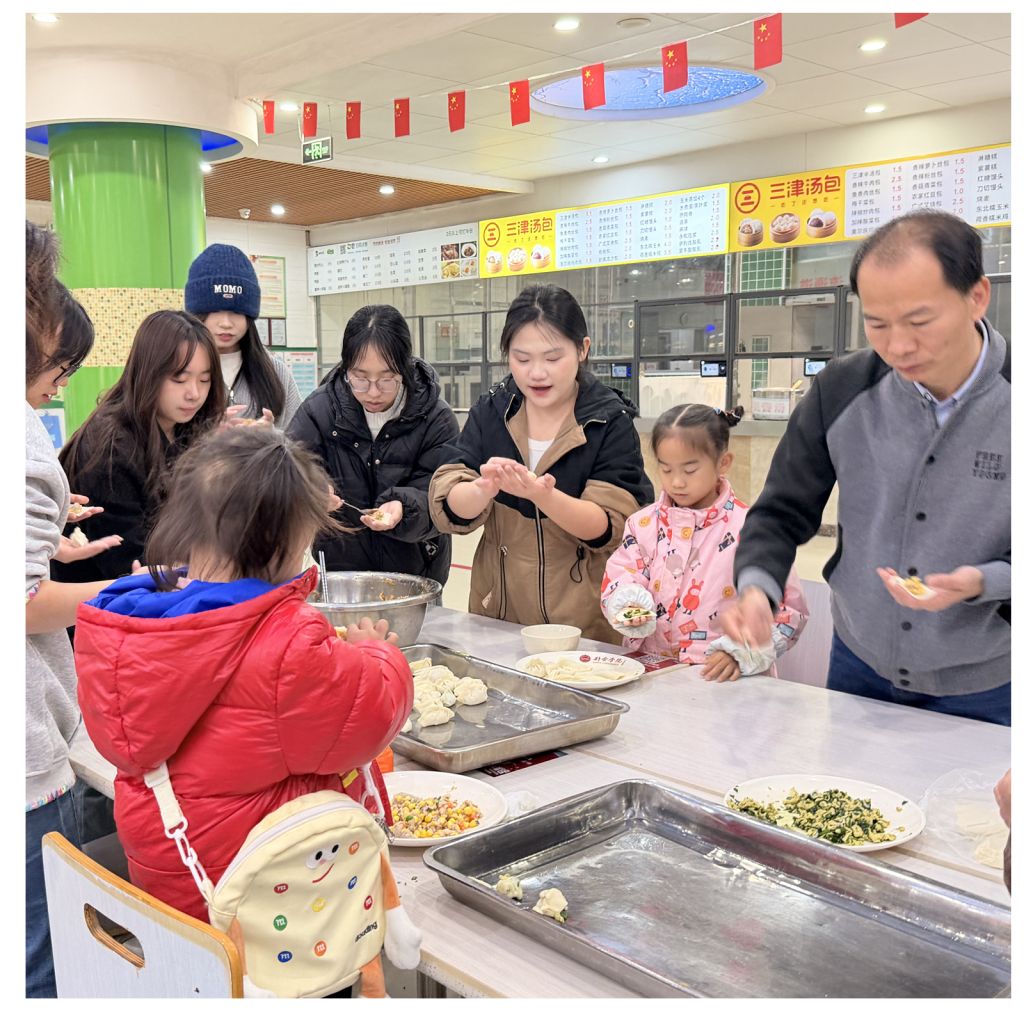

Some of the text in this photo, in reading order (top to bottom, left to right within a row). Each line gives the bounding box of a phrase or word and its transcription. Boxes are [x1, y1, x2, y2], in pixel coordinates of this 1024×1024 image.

[770, 175, 840, 199] 三津汤包
[506, 217, 553, 236] 三津汤包
[214, 284, 243, 294] MOMO
